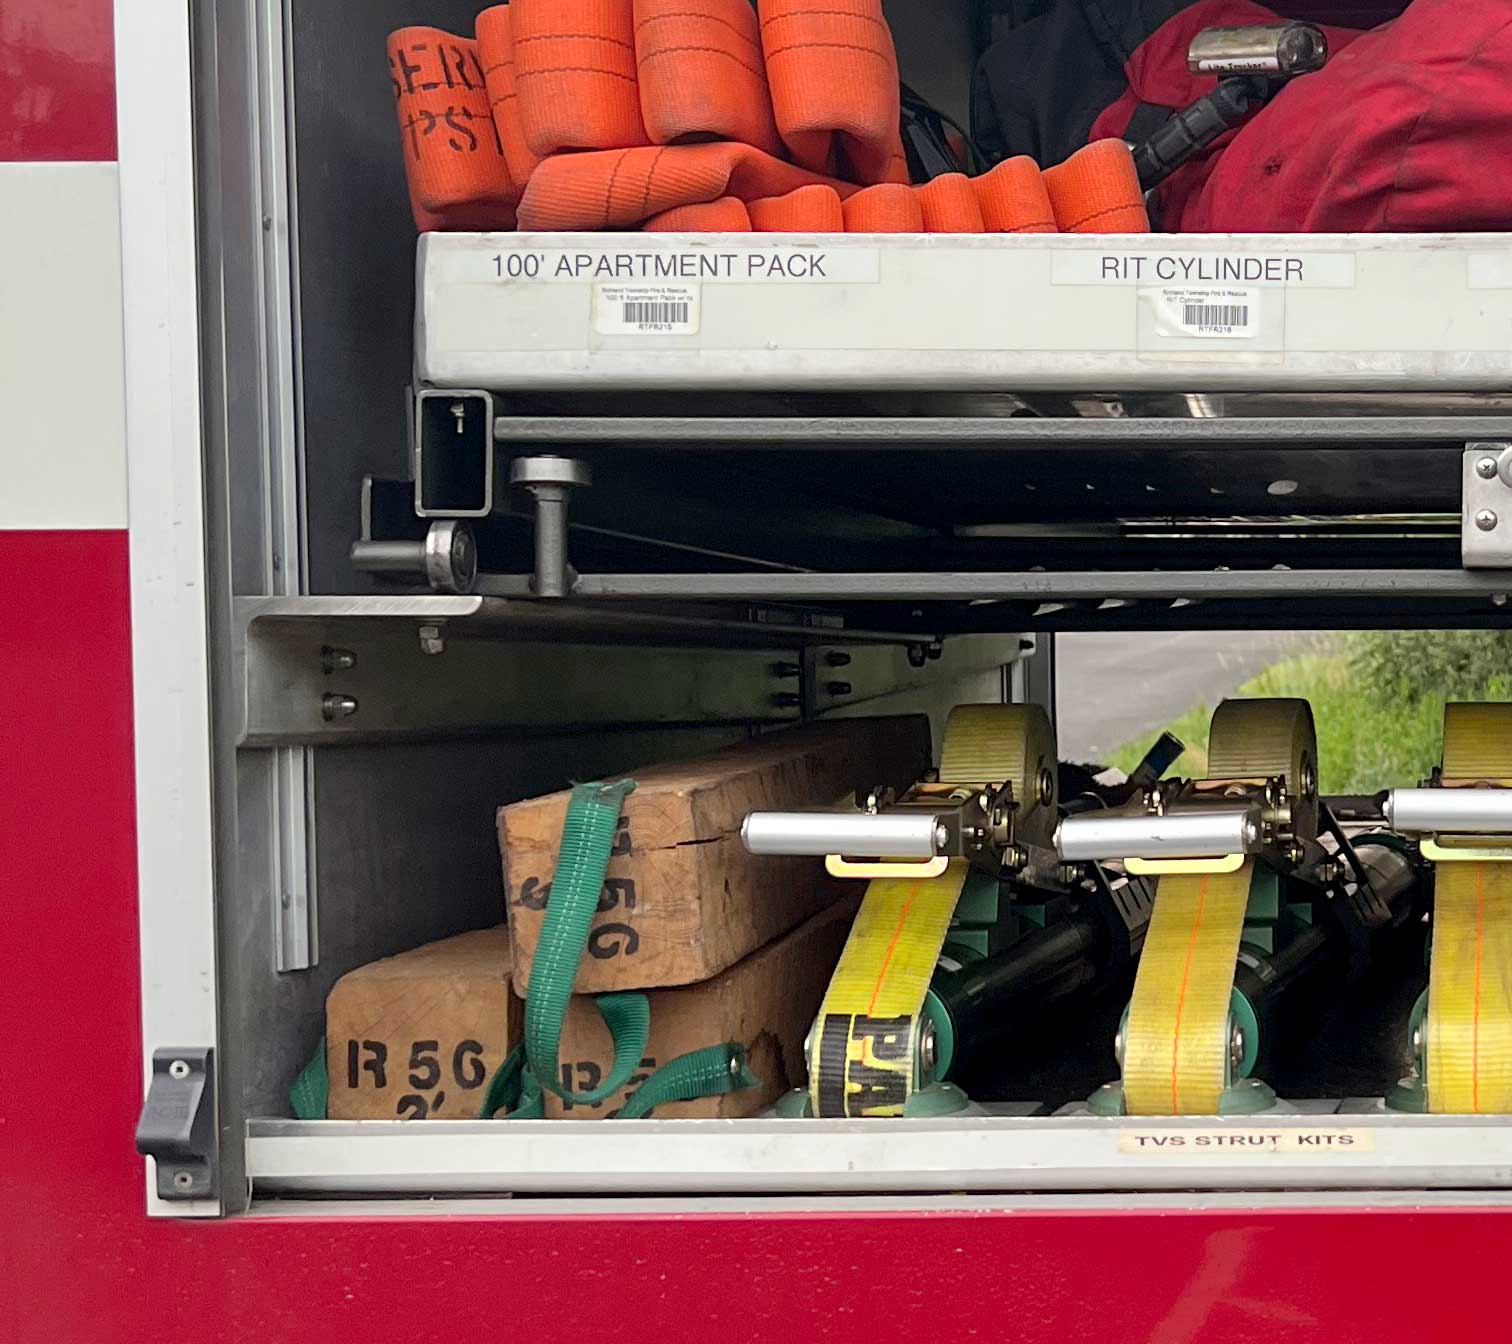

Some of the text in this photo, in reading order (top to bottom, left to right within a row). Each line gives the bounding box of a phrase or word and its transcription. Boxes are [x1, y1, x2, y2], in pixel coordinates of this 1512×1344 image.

[493, 253, 827, 278] 100' APARTMENT PACK
[1101, 256, 1304, 281] RIT CYLINDER
[1134, 1133, 1356, 1147] TVS STRUT KITS
